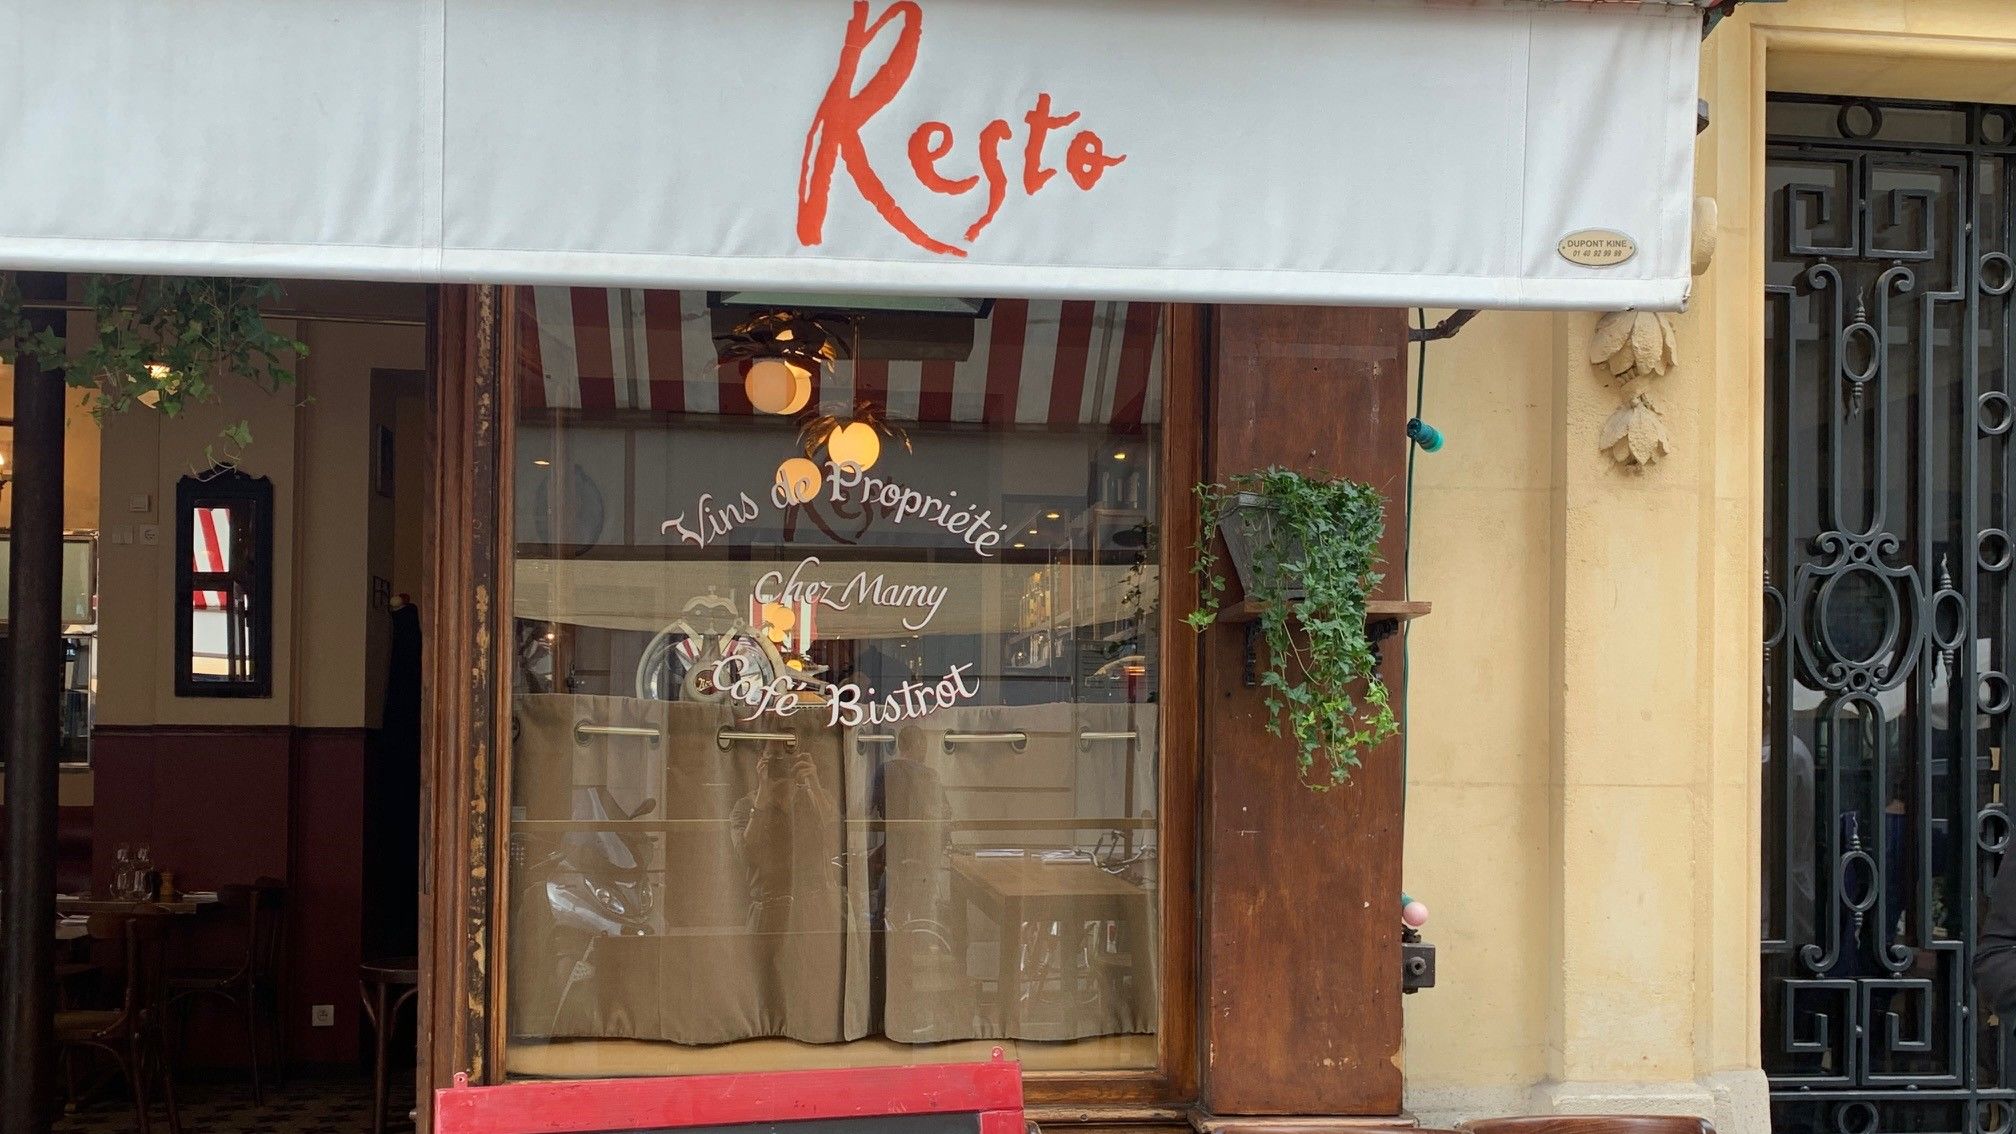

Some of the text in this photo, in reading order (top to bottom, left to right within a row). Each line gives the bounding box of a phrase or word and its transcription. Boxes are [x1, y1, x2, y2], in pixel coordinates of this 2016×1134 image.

[797, 0, 1127, 257] Resto
[1567, 240, 1604, 248] DUPONT
[1573, 249, 1581, 257] 01
[661, 491, 760, 549] Vins
[771, 469, 811, 509] de
[824, 460, 1008, 557] Propriété
[754, 556, 948, 631] Chez Mamy
[712, 654, 981, 728] Café Bistrot
